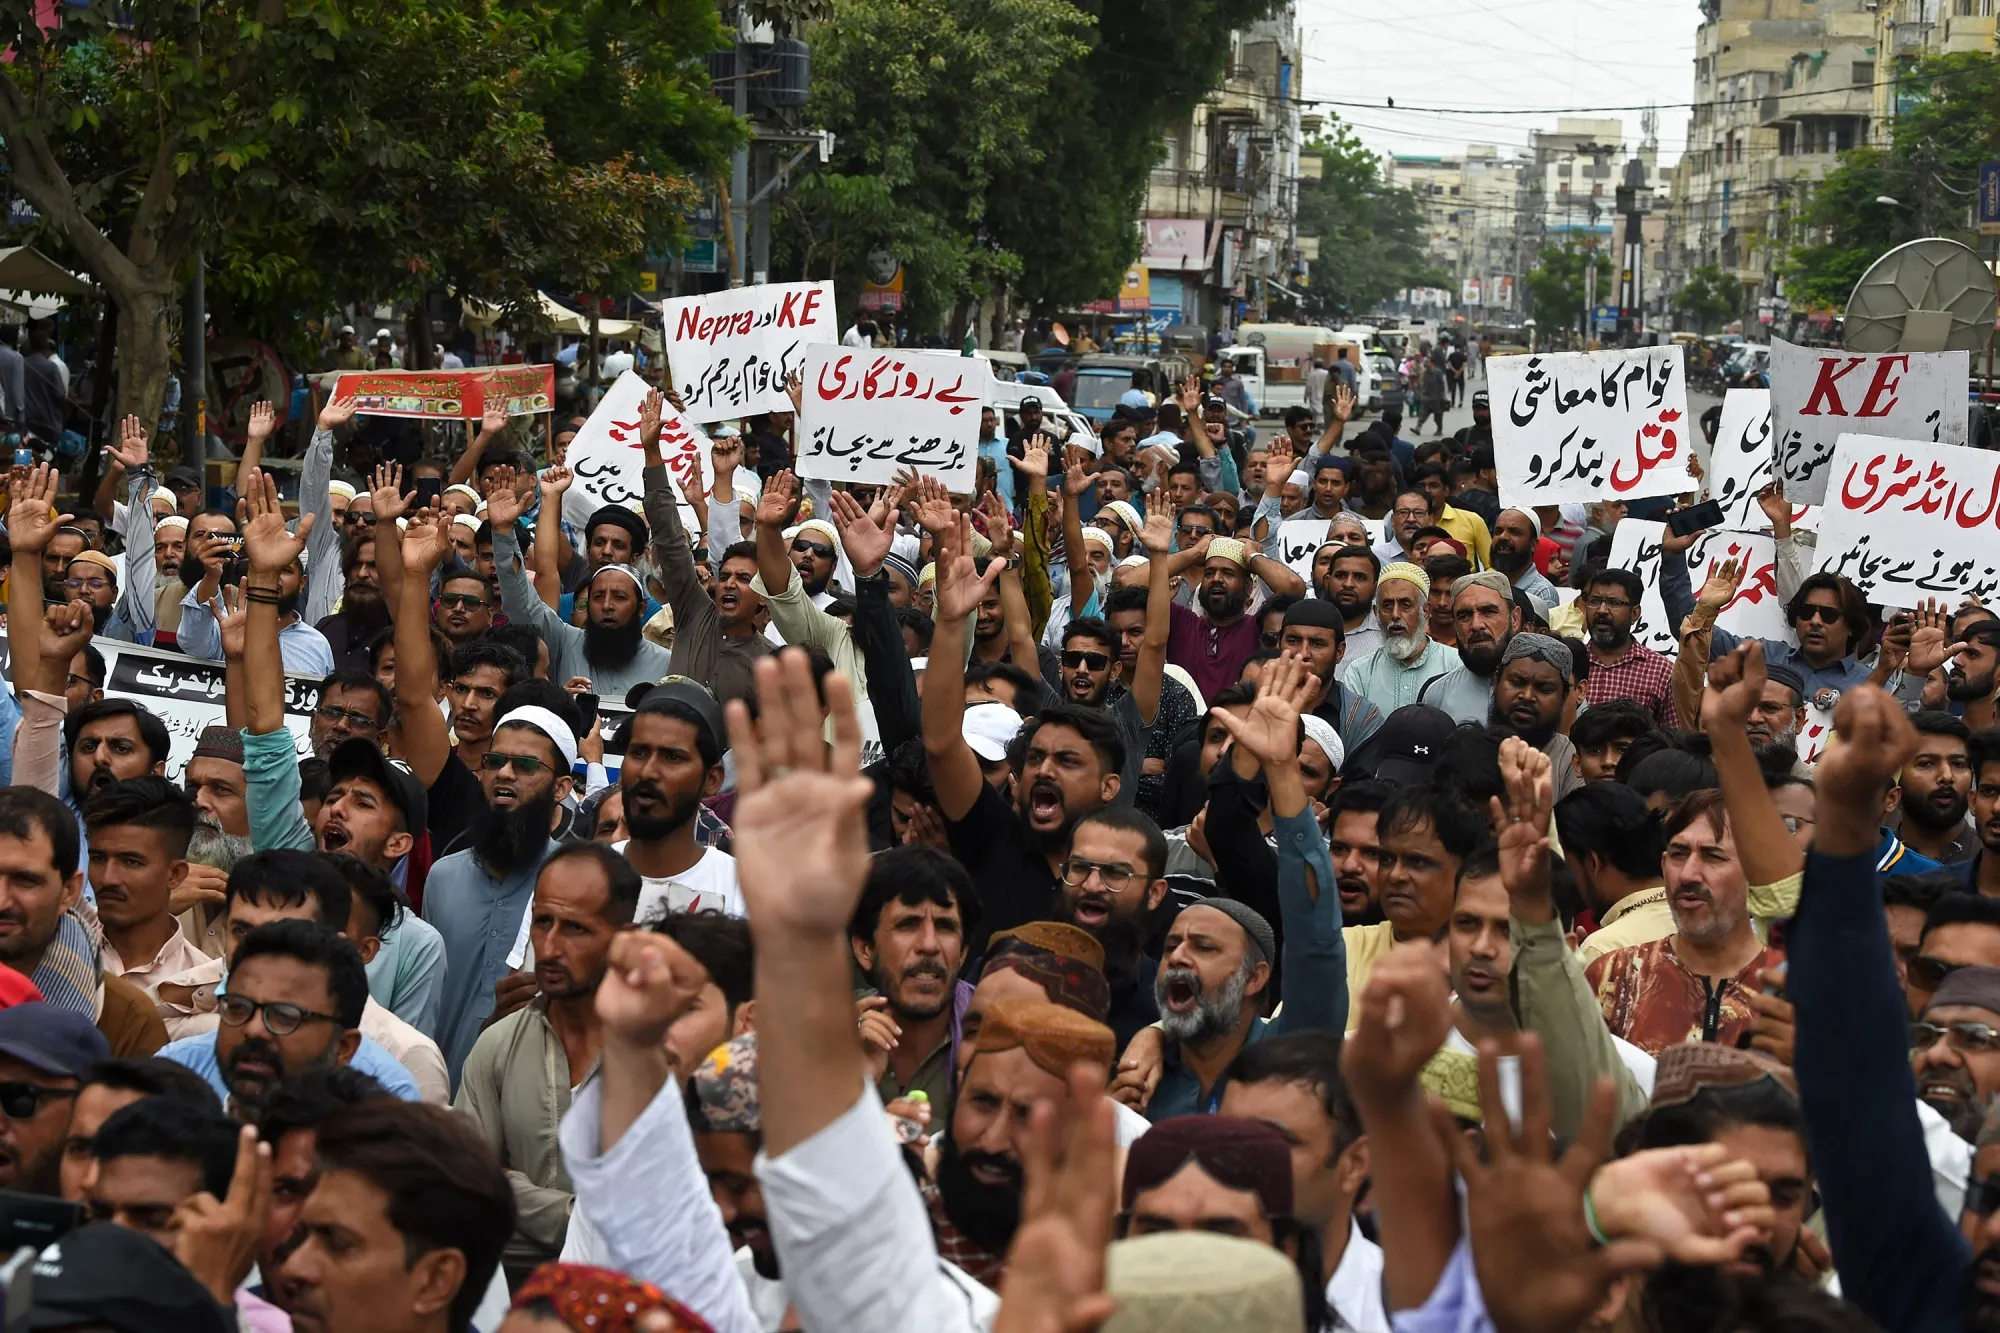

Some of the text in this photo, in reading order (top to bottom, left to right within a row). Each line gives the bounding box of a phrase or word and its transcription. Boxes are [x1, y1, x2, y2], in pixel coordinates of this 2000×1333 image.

[676, 290, 823, 344] KE اور Nepra
[679, 364, 713, 407] کرو
[723, 371, 742, 407] پر
[744, 355, 771, 403] عوام
[818, 355, 935, 401] روزگاری
[935, 375, 980, 416] بے
[1510, 356, 1674, 428] عوام کا معاشی
[1799, 354, 1909, 417] KE
[867, 438, 895, 460] سے
[895, 437, 966, 471] بڑھنے
[1524, 408, 1682, 493] قتل بند کرو
[1841, 453, 1957, 521] انڈسٹری
[1882, 558, 1915, 583] سے
[1915, 548, 1976, 592] ہونے
[136, 664, 212, 694] تحریک
